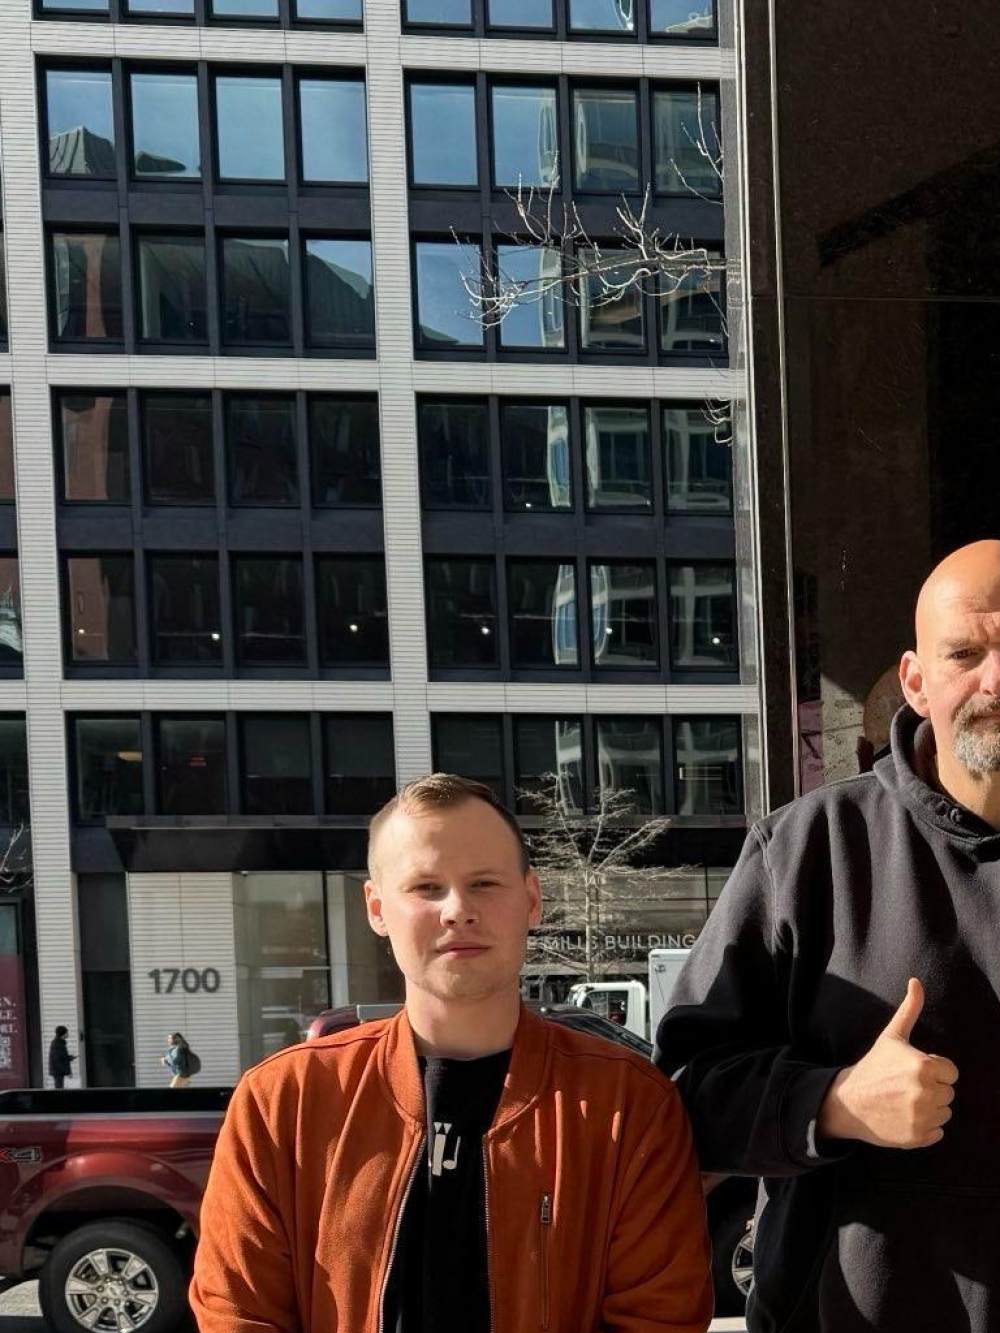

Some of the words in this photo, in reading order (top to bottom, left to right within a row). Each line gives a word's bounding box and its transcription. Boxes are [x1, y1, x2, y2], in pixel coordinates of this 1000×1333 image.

[544, 935, 597, 950] MILLS
[605, 934, 695, 949] BUILDING
[147, 968, 220, 993] 1700
